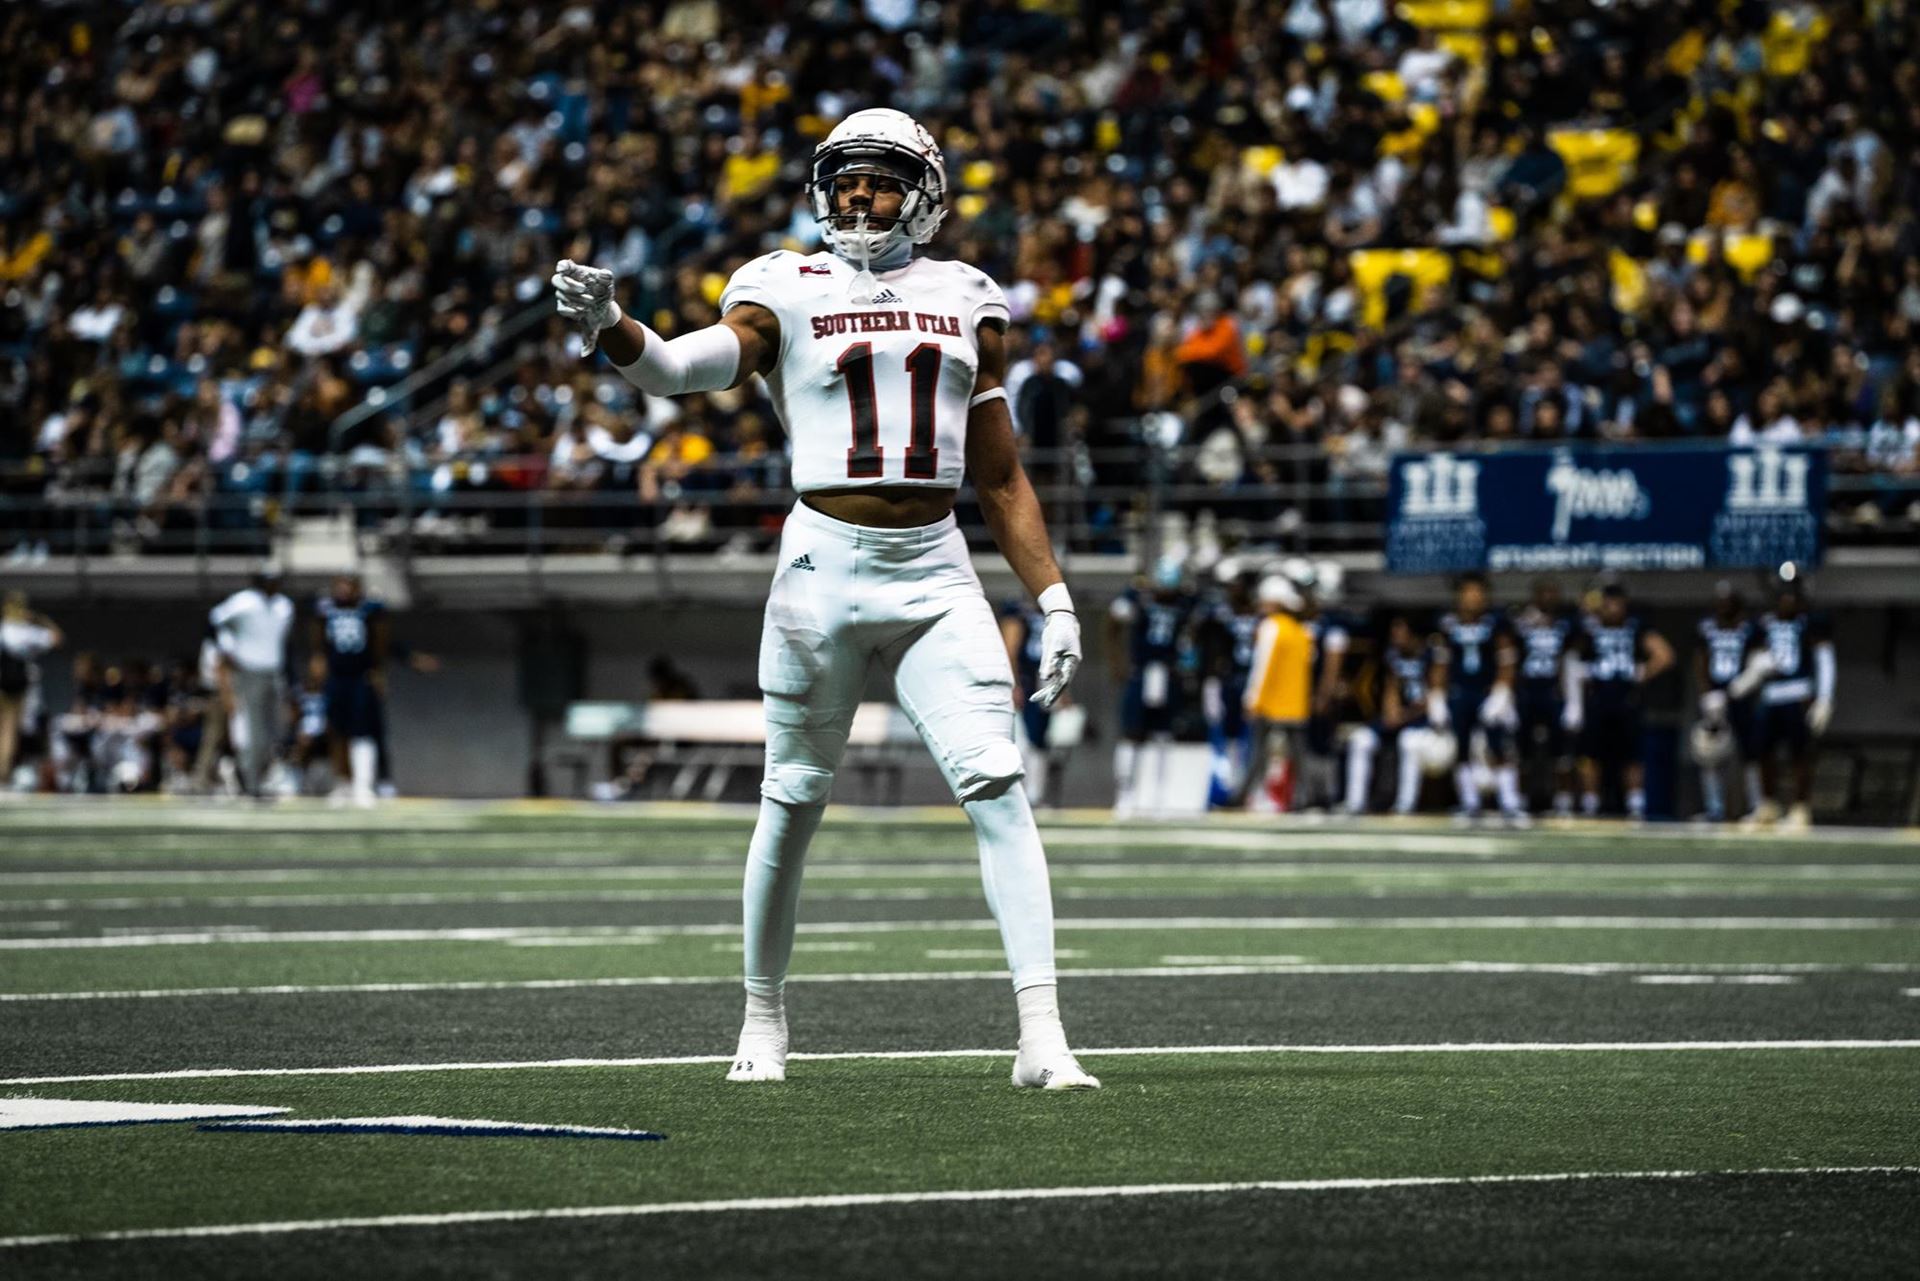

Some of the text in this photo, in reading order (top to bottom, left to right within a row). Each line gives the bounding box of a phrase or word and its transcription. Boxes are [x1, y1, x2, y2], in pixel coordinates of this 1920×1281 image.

[810, 310, 962, 339] SOUTHERN UTAH
[836, 341, 942, 479] 11
